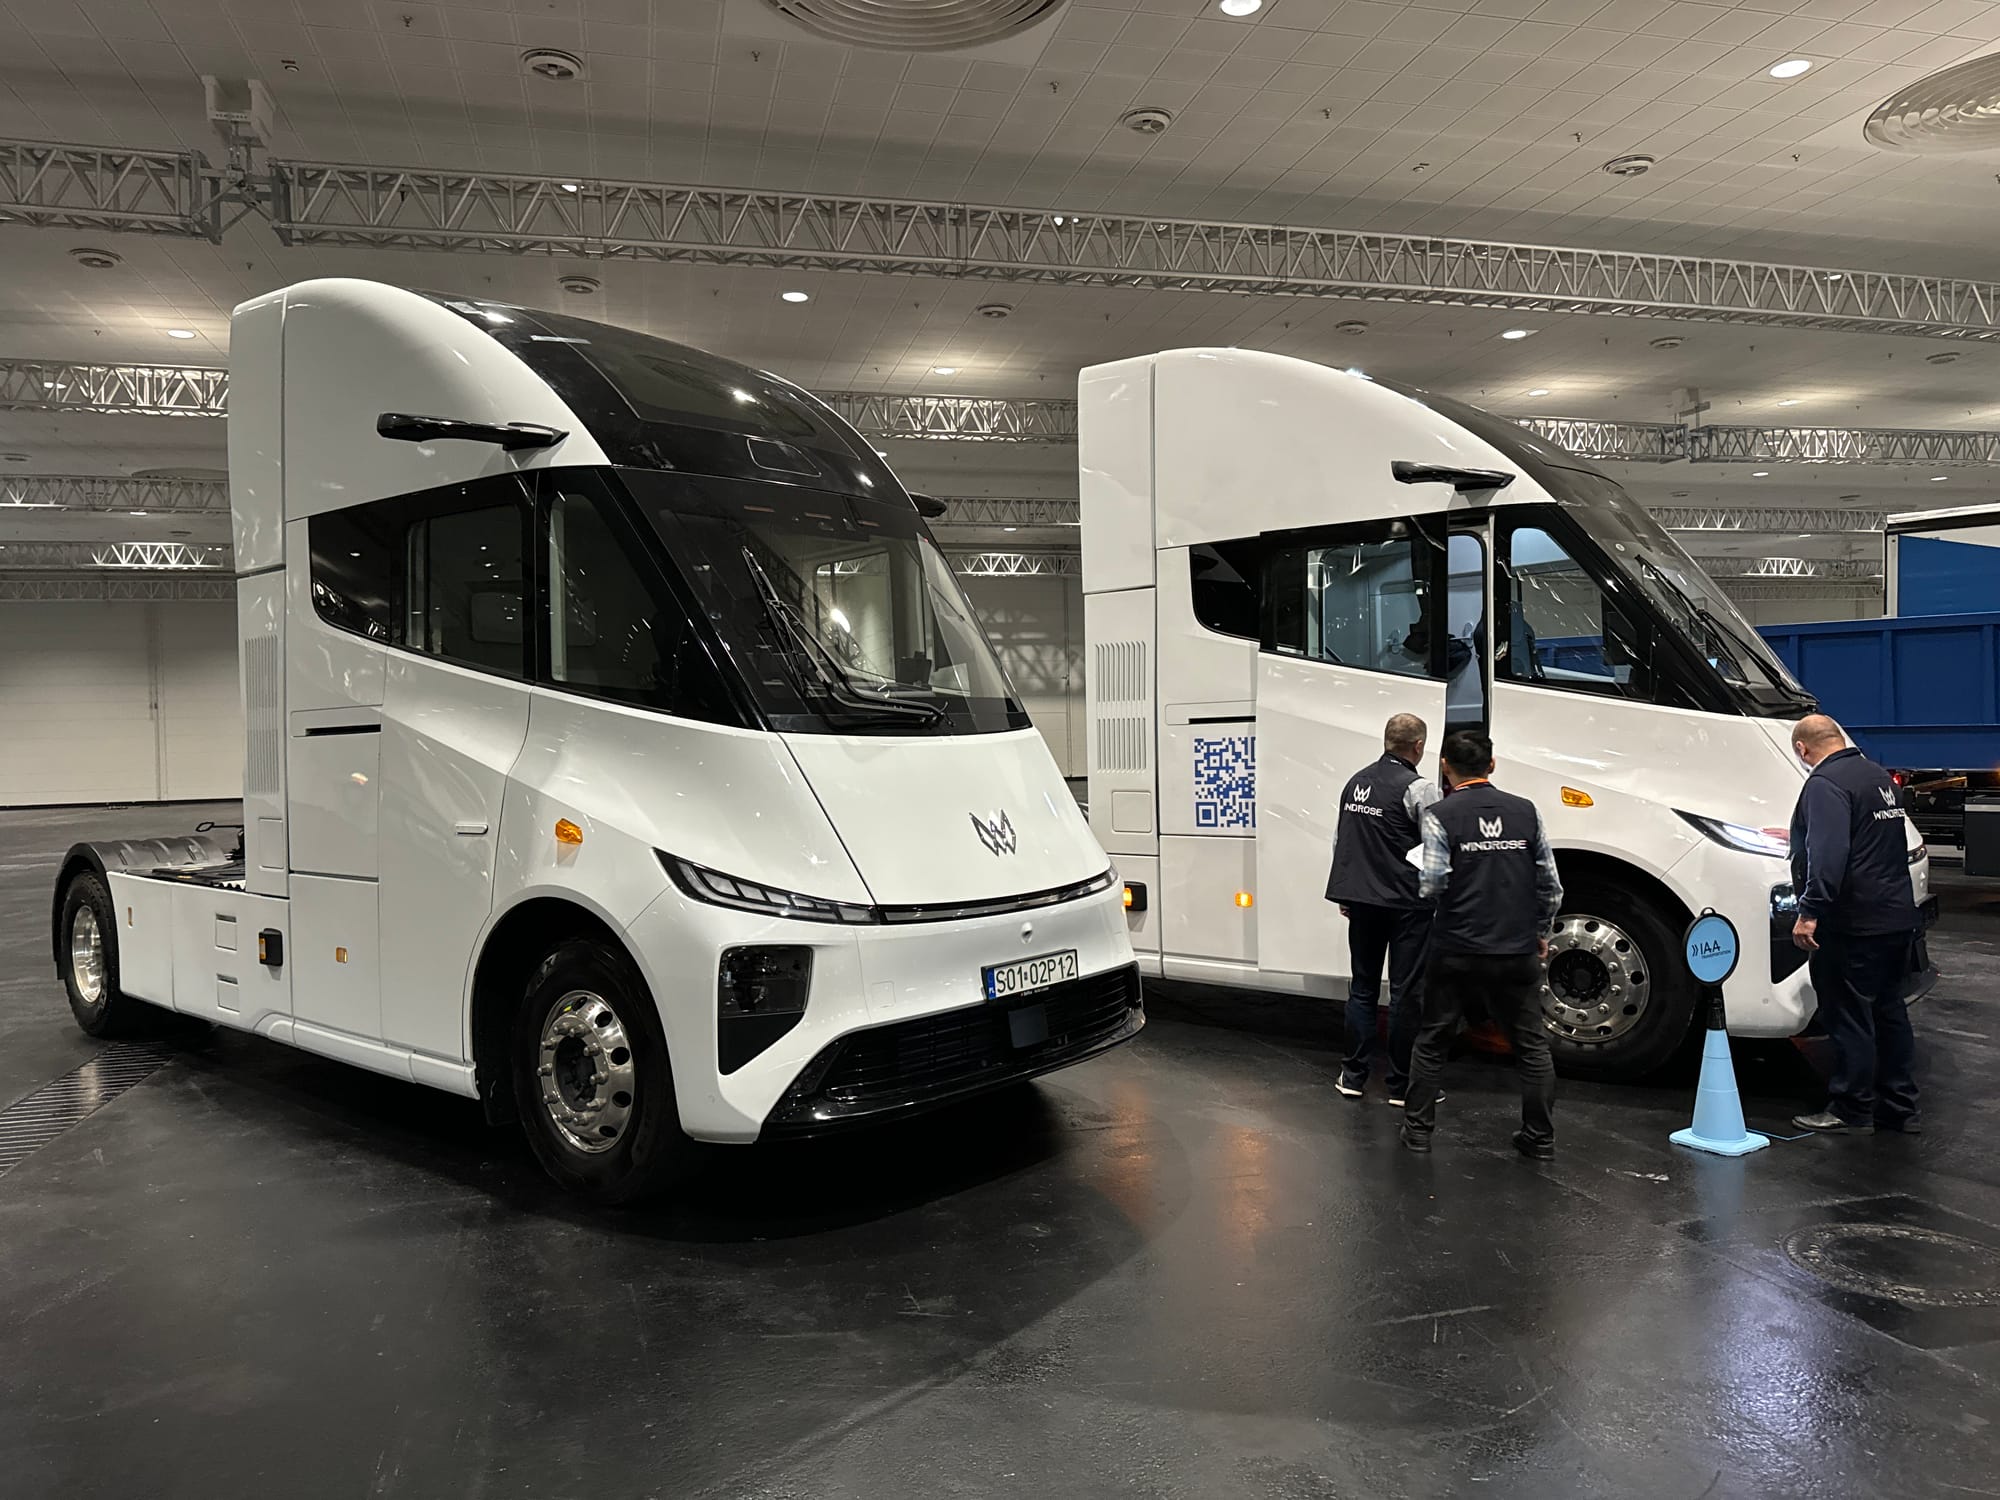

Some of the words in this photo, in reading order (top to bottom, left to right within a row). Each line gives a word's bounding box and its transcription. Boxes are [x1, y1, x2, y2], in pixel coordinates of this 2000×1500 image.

[1872, 808, 1905, 820] WINDROS
[1460, 840, 1527, 852] WINDROSE
[1700, 939, 1721, 955] IAA
